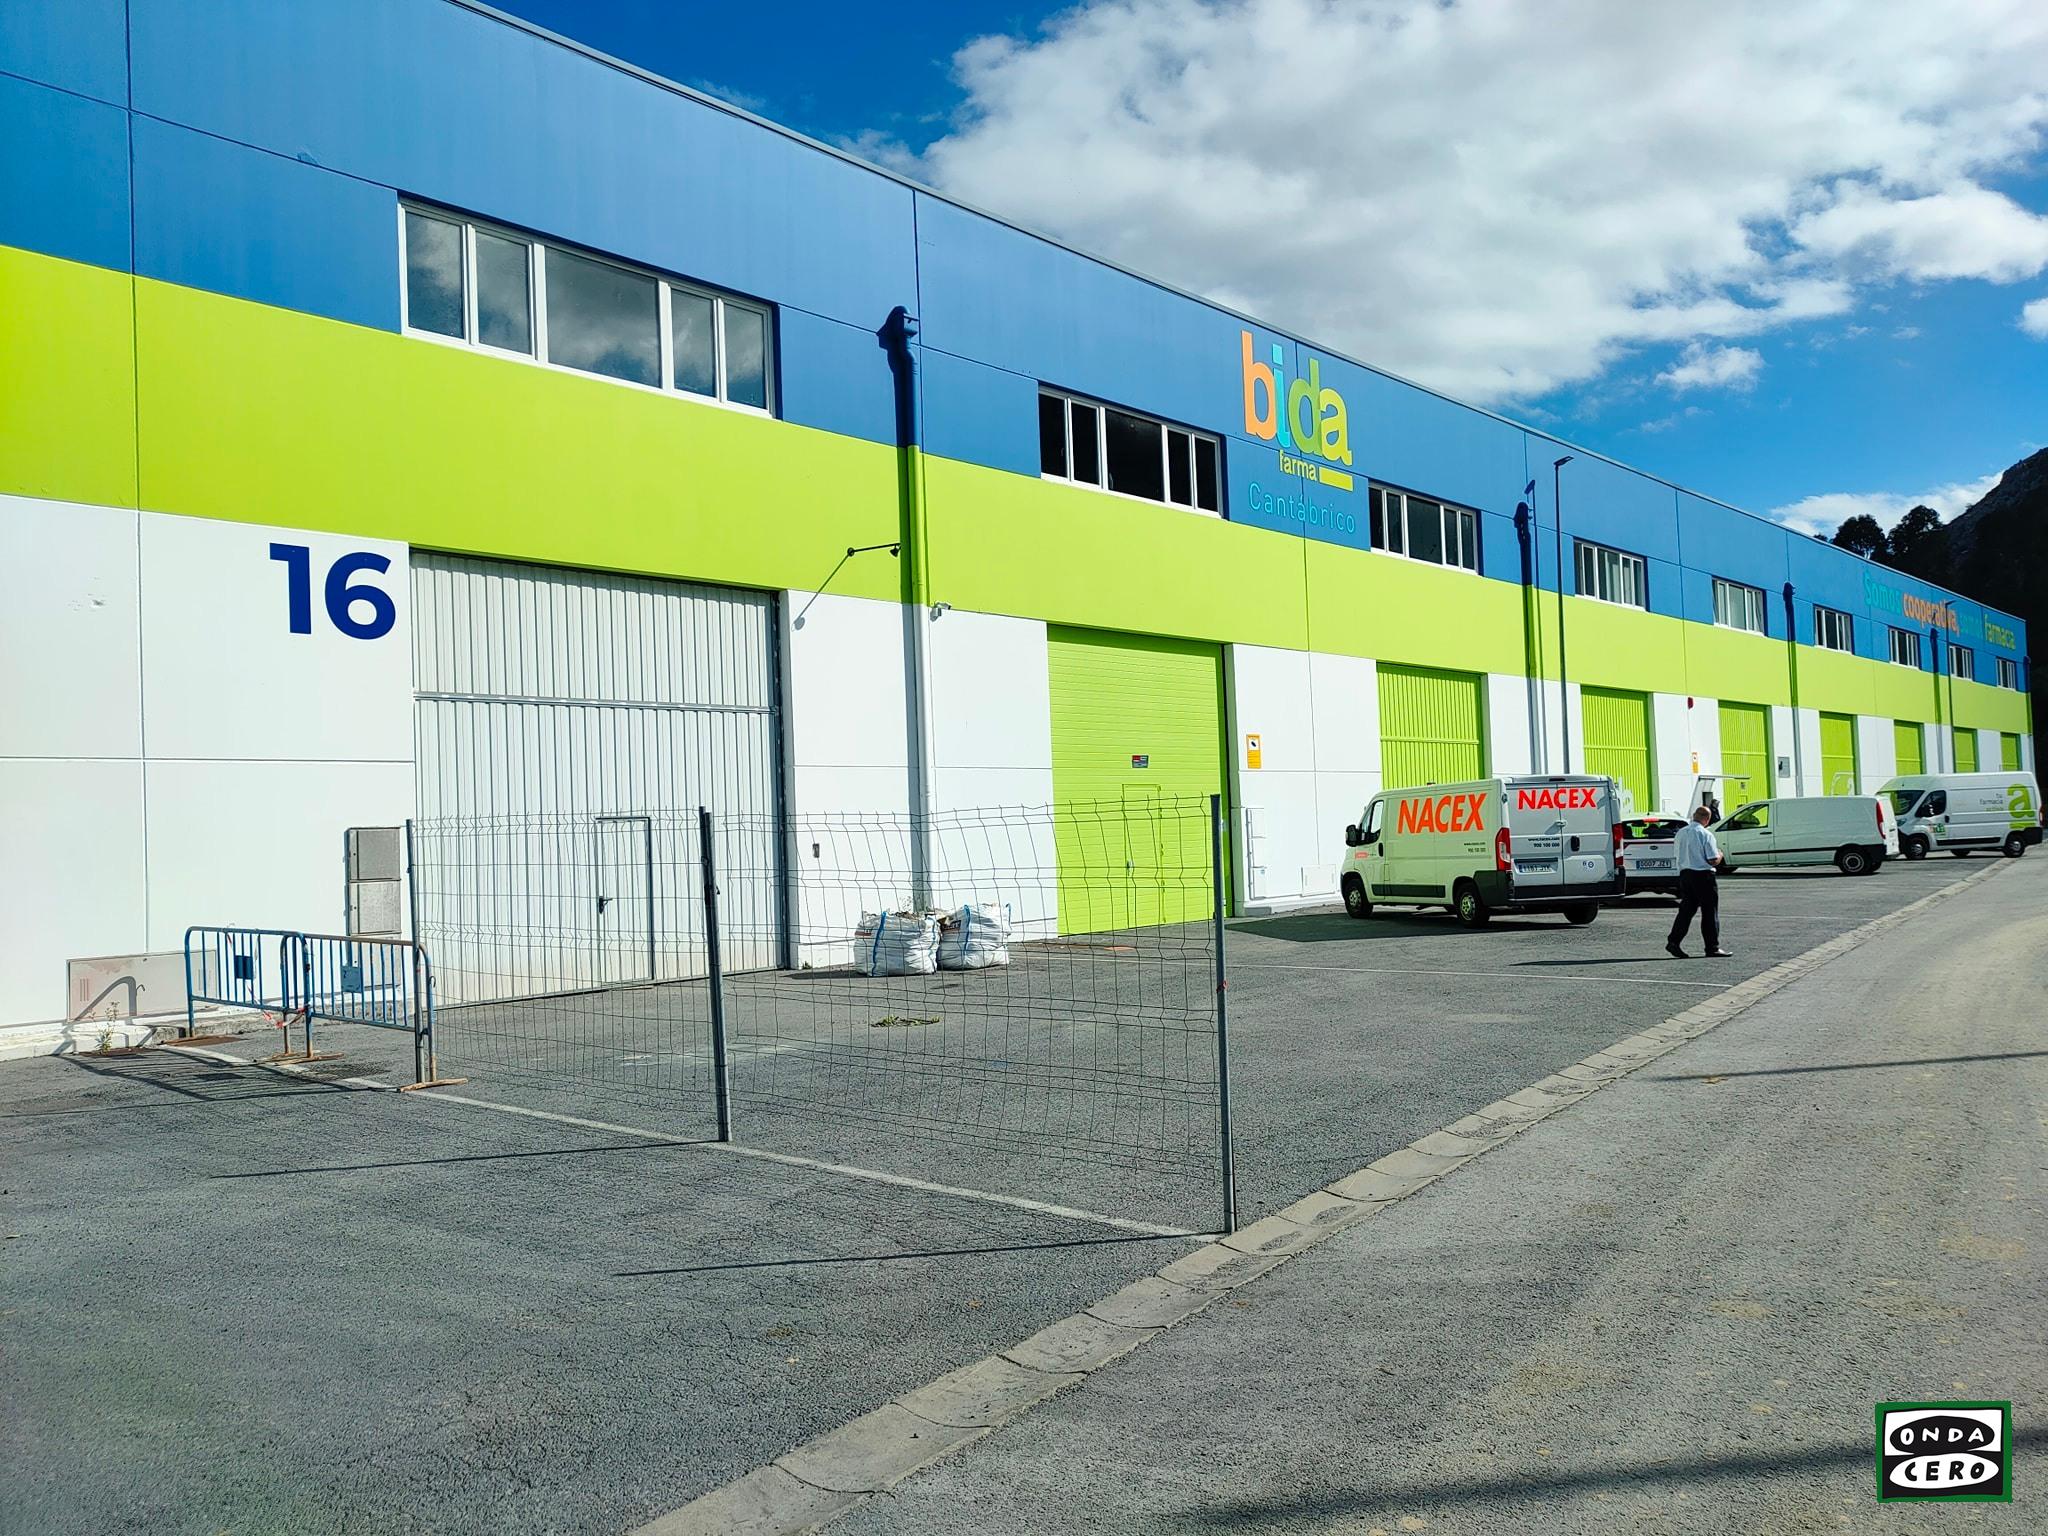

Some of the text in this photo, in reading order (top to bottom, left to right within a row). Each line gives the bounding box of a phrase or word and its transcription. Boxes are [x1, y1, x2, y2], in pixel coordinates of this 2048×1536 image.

[1241, 330, 1352, 465] bida
[1279, 449, 1318, 482] farma
[1249, 483, 1356, 533] Cantábrico
[269, 542, 396, 640] 16
[1397, 793, 1487, 834] NACEX
[1518, 788, 1598, 809] NACEX
